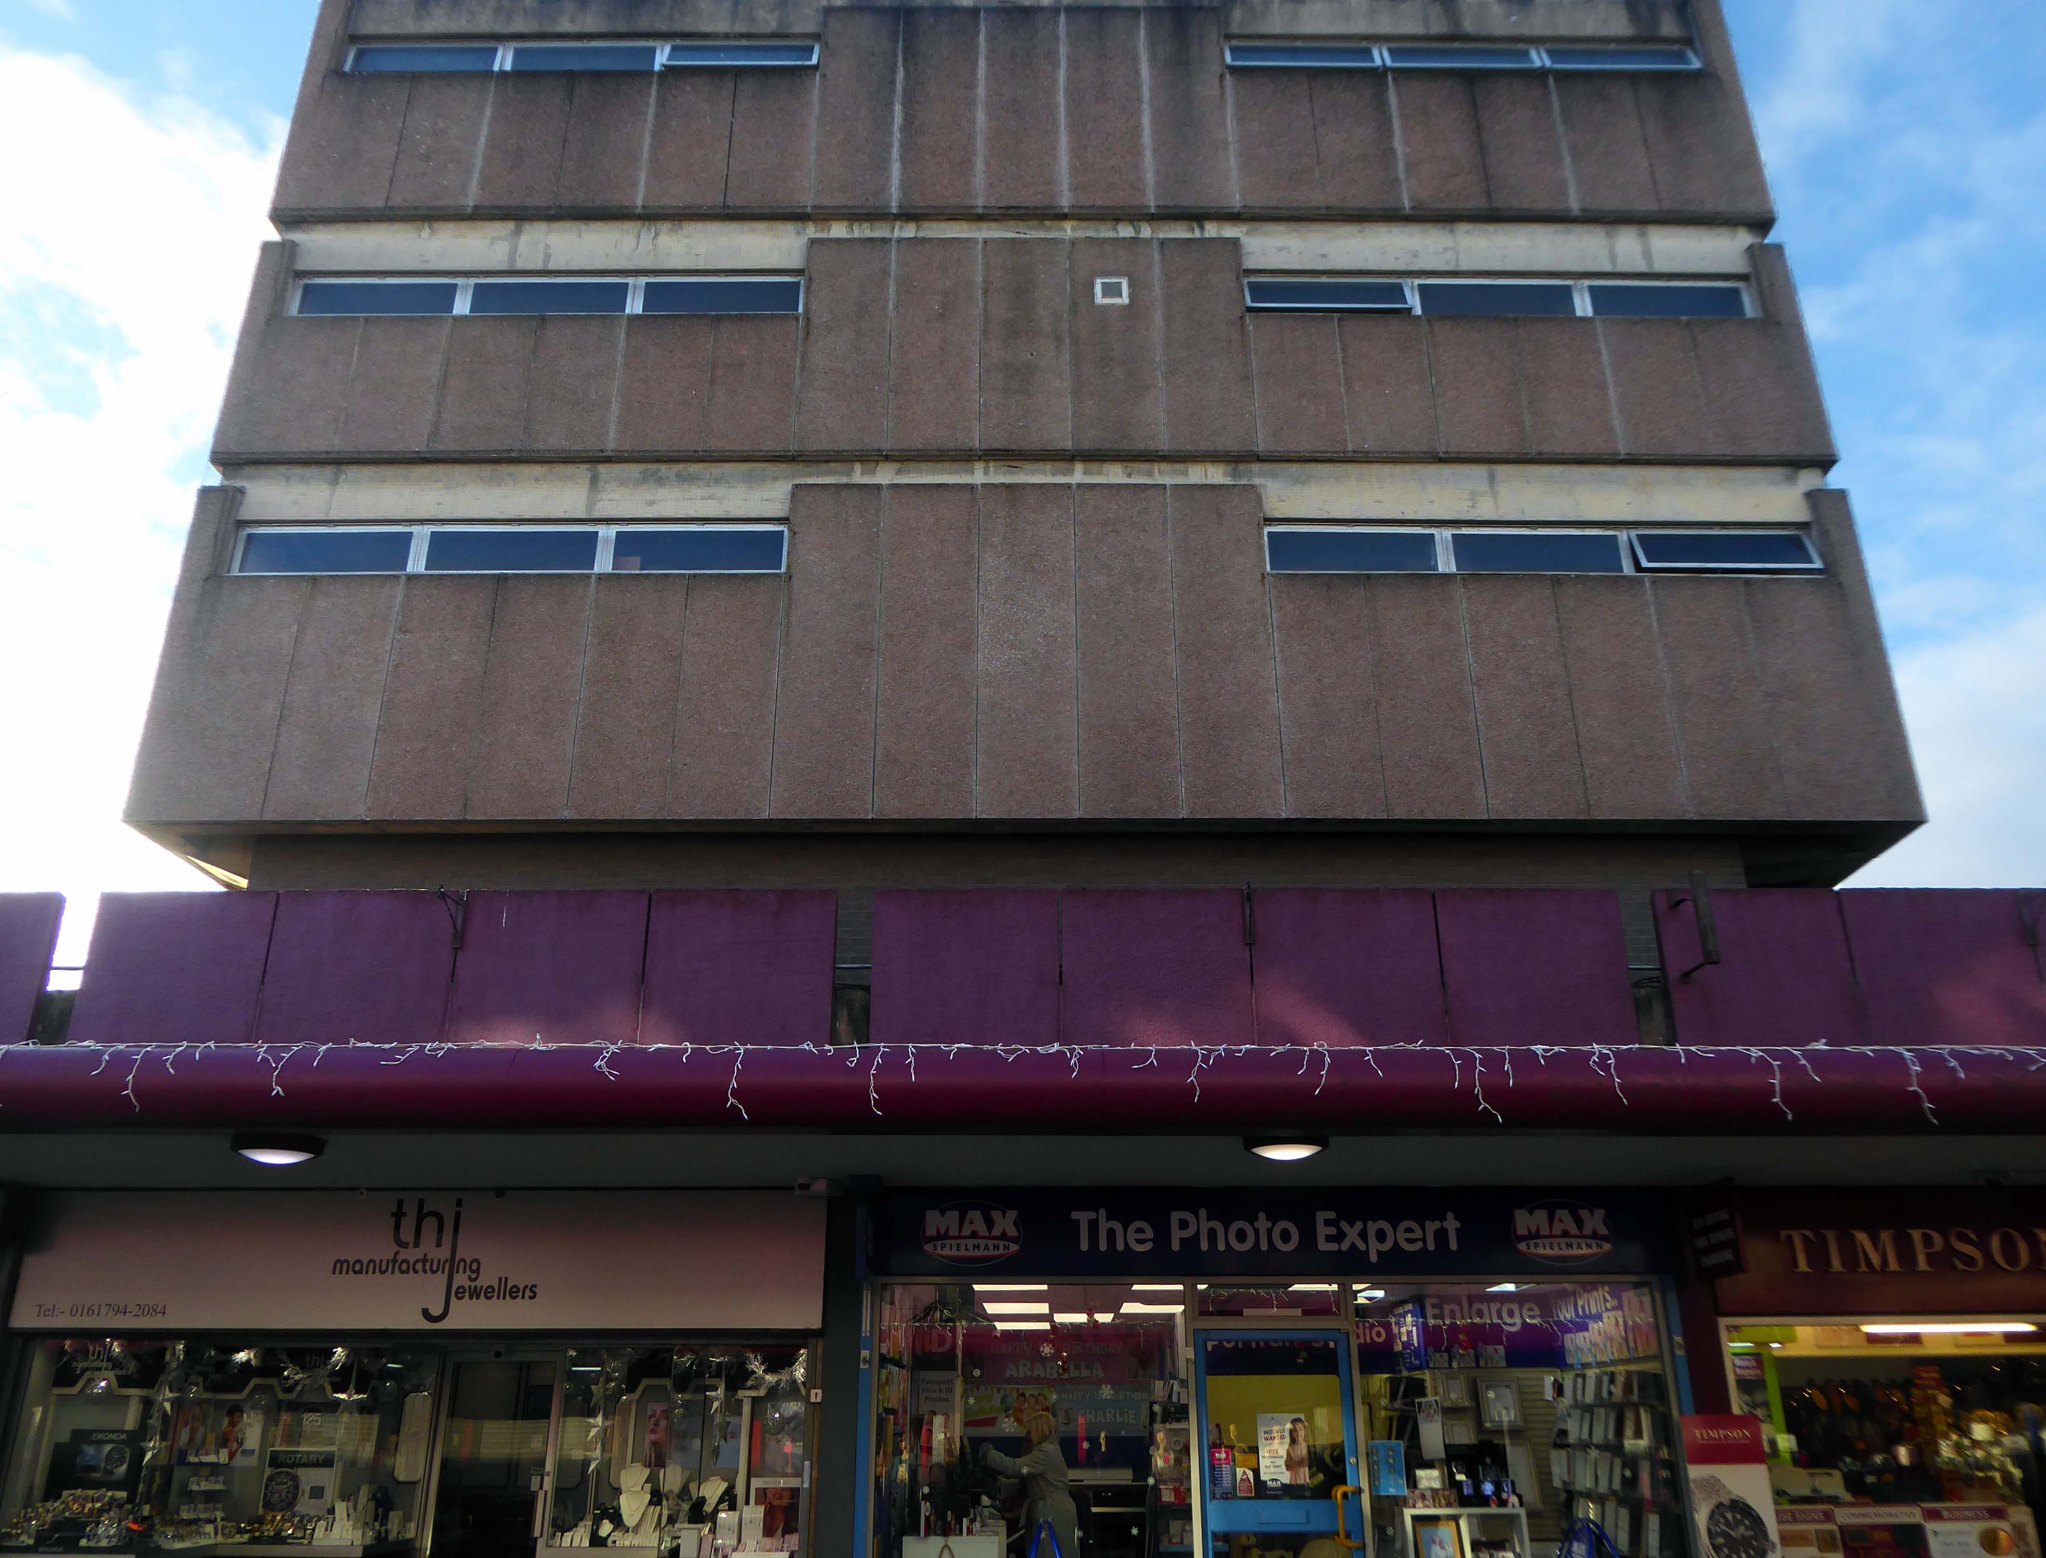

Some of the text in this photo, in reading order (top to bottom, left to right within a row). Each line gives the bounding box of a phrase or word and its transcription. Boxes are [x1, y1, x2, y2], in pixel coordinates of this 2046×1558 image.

[923, 1209, 1020, 1238] MAX
[1514, 1208, 1609, 1238] MAX
[1071, 1207, 1463, 1263] The Photo Expert
[929, 1241, 1014, 1254] SPIELMANN
[1523, 1240, 1607, 1254] SPIELMANN
[1778, 1226, 2046, 1274] TIMPSO
[69, 1302, 168, 1320] 0161794-2084
[1426, 1295, 1542, 1332] Enlarge
[1694, 1427, 1751, 1440] TIMPSON
[277, 1453, 326, 1464] ROTARY
